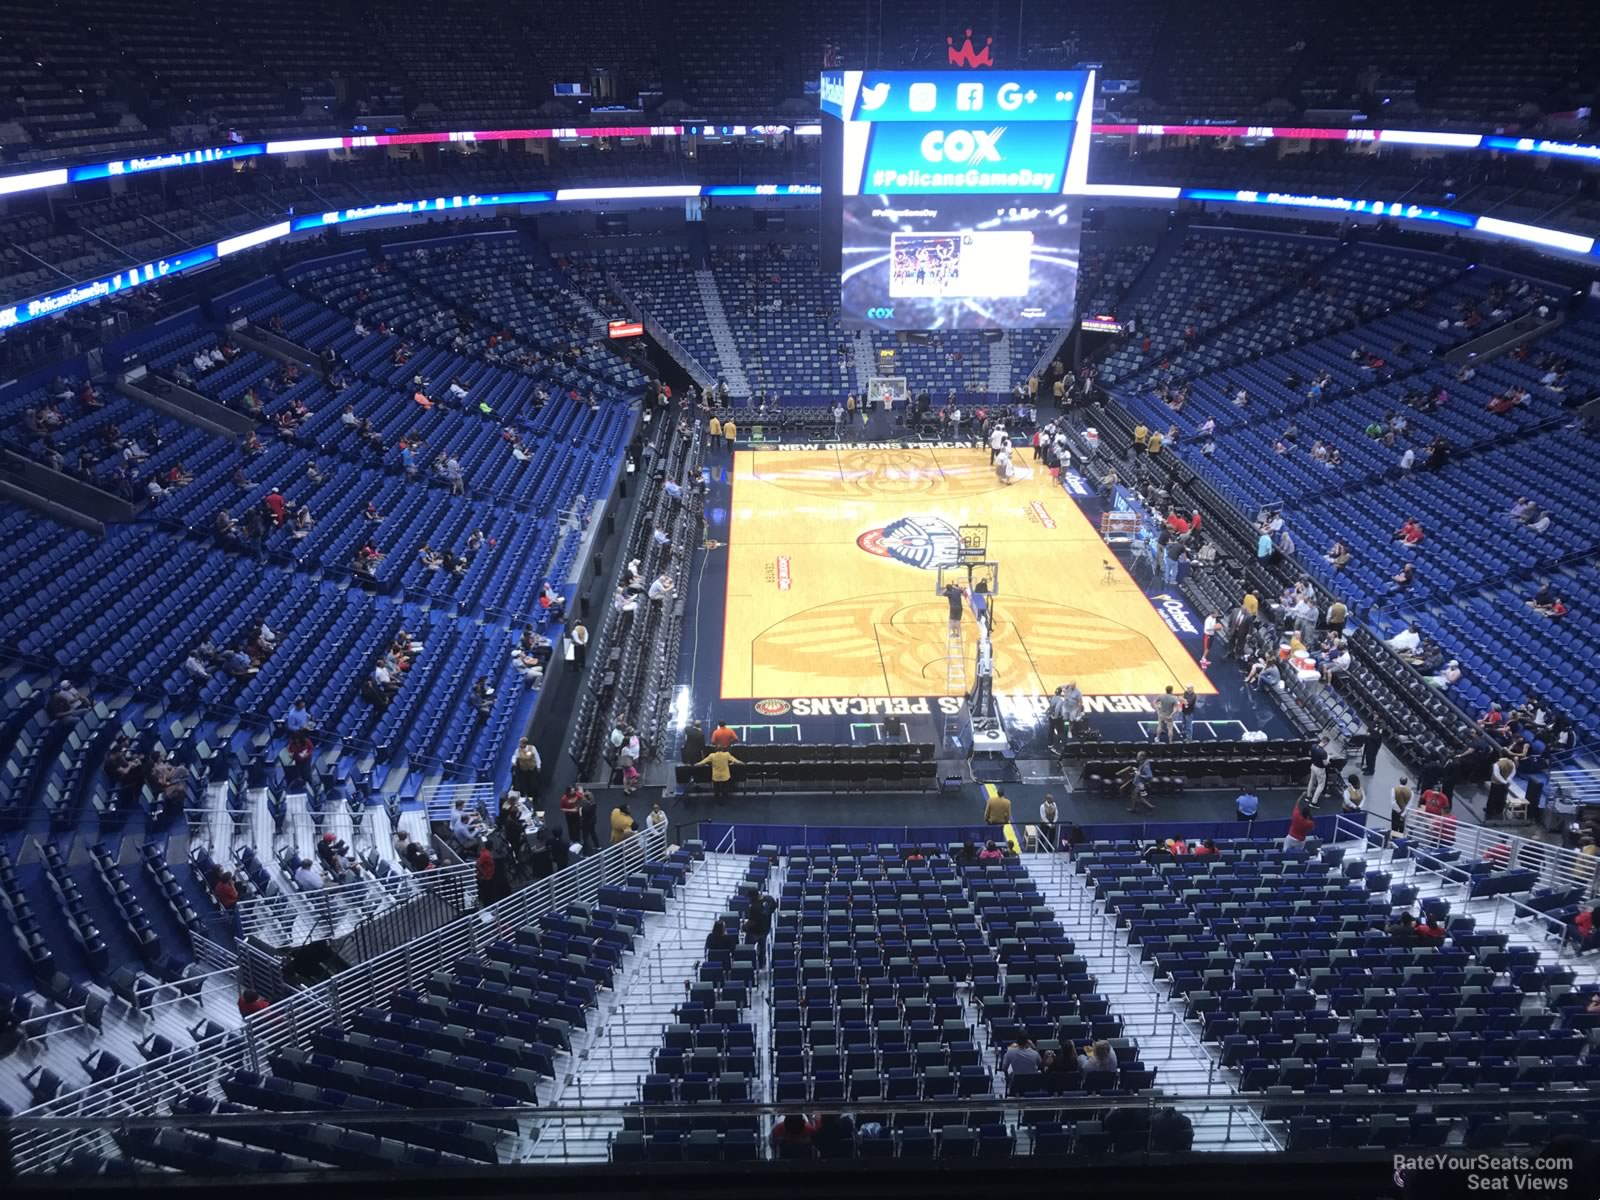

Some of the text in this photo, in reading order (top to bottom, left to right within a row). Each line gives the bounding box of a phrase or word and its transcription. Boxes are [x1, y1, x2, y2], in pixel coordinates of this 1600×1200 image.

[920, 126, 1008, 167] COX
[872, 169, 1056, 190] #PelicansGameDay
[867, 308, 895, 319] COX
[778, 443, 819, 451] NEW
[825, 442, 901, 450] ORLEANS
[1162, 601, 1199, 634] Ochsner
[791, 697, 932, 716] PELICANS
